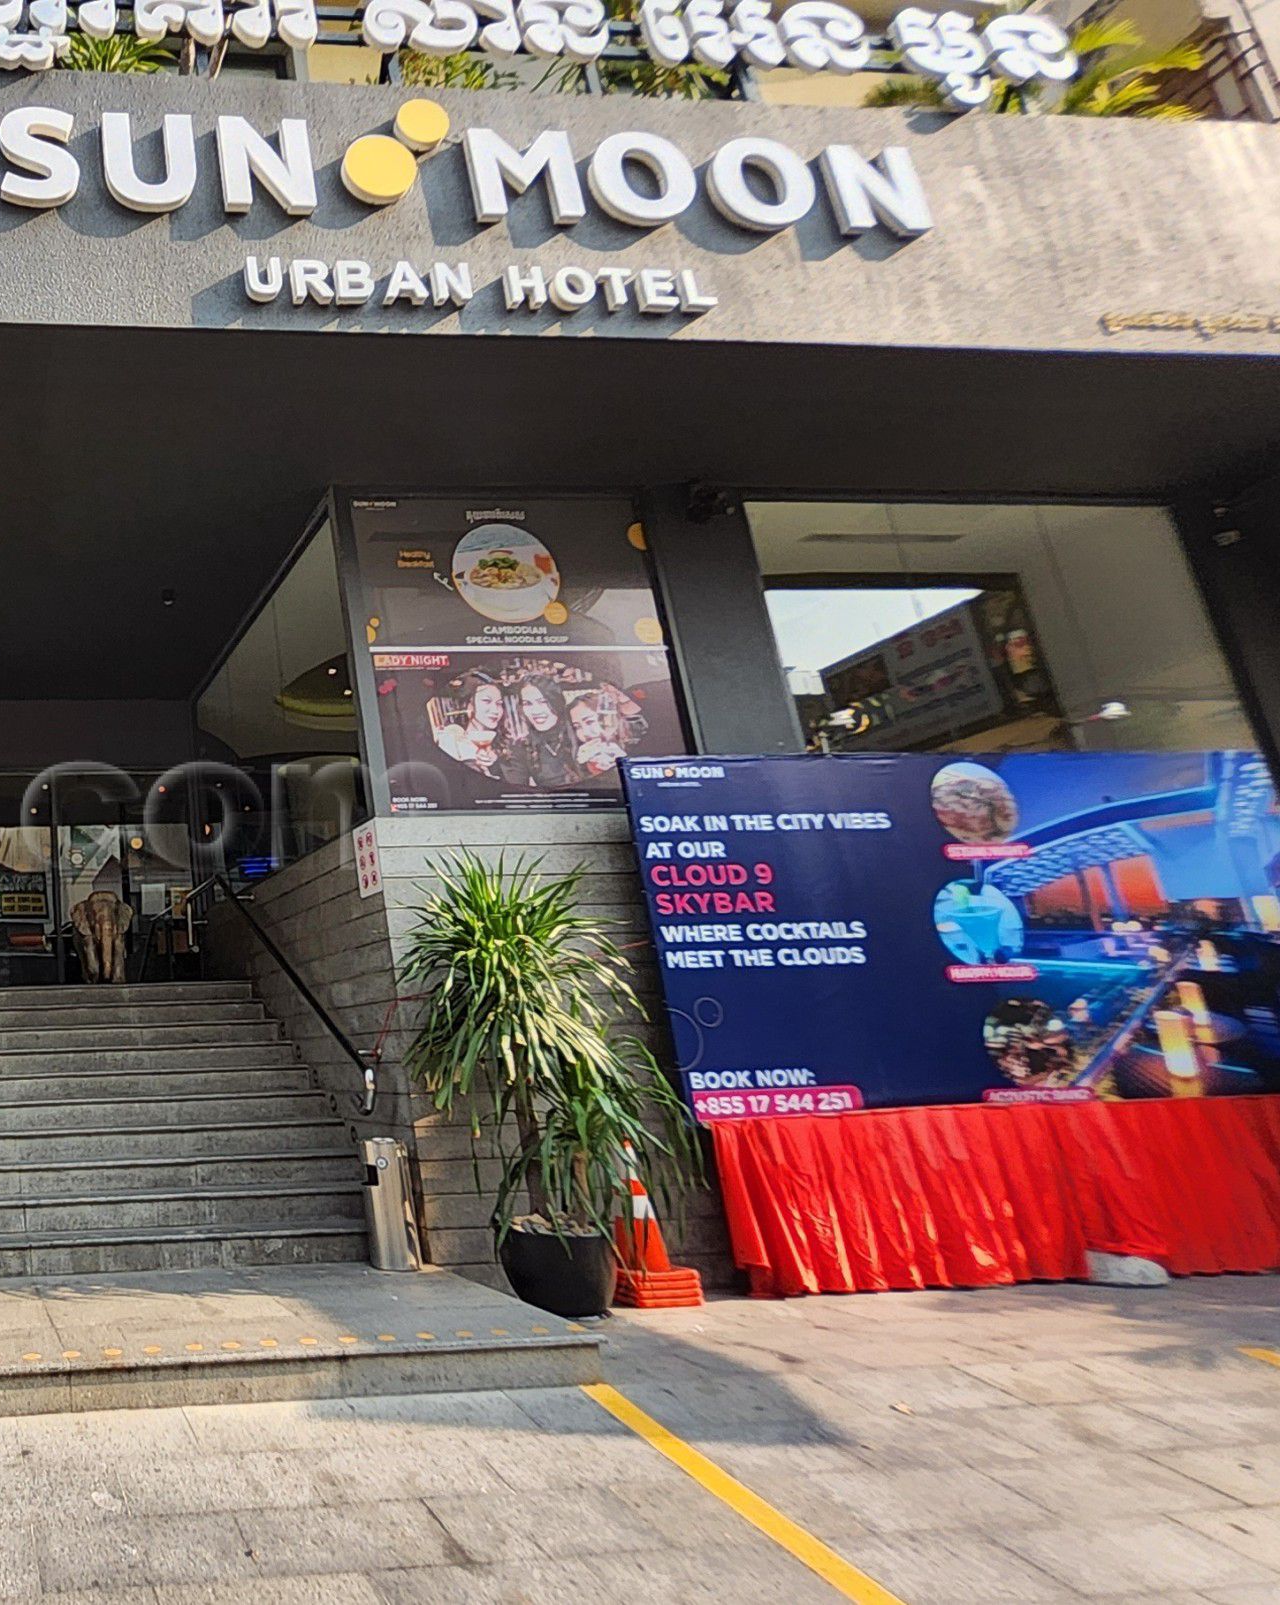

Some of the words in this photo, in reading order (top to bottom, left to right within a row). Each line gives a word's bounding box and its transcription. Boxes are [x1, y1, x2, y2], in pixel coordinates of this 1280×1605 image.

[0, 106, 317, 215] SUN
[463, 128, 933, 237] MOON
[244, 255, 474, 305] URBAN
[505, 265, 718, 314] HOTEL
[483, 626, 548, 635] CAMBODIAN
[410, 654, 449, 667] NIGHT
[630, 767, 664, 779] SUN
[675, 766, 725, 778] MOON
[639, 815, 702, 832] SOAK
[704, 815, 728, 831] IN
[730, 814, 775, 831] THE
[777, 813, 825, 830] CITY
[827, 812, 892, 829] VIBES
[646, 842, 673, 859] AT
[677, 841, 727, 858] OUR
[651, 864, 748, 886] CLOUD
[754, 863, 774, 885] 9
[655, 892, 776, 915] SKYBAR
[660, 924, 744, 942] WHERE
[746, 921, 868, 940] COCKTAILS
[665, 950, 725, 968] MEET
[728, 949, 775, 967] THE
[777, 947, 867, 965] CLOUDS
[689, 1070, 754, 1089] BOOK
[755, 1068, 817, 1087] NOW:
[694, 1096, 746, 1115] +855
[747, 1095, 770, 1113] 17
[773, 1094, 815, 1112] 544
[817, 1092, 854, 1110] 251
